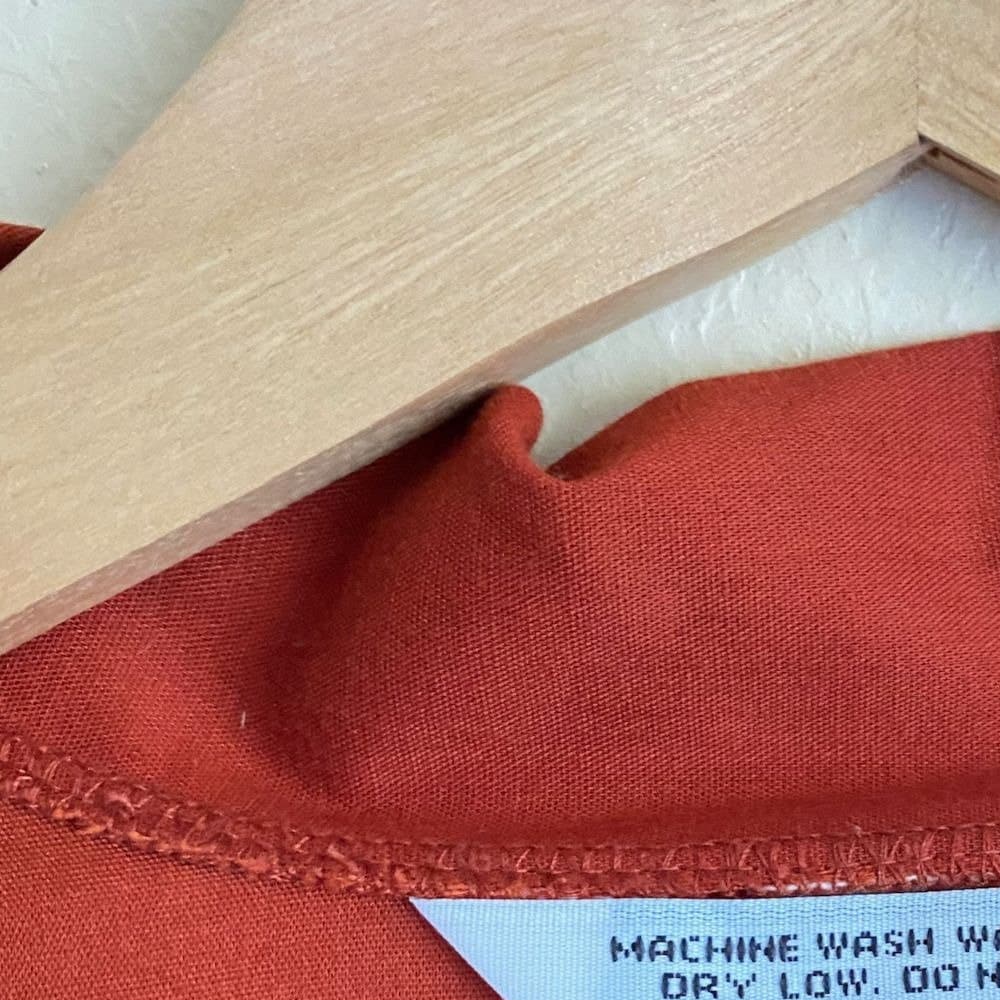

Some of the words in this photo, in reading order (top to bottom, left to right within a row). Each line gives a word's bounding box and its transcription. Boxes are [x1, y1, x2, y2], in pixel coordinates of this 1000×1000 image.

[610, 934, 799, 963] MACHINE
[817, 928, 934, 960] WASH
[661, 972, 757, 1000] DRY
[903, 963, 960, 993] DO
